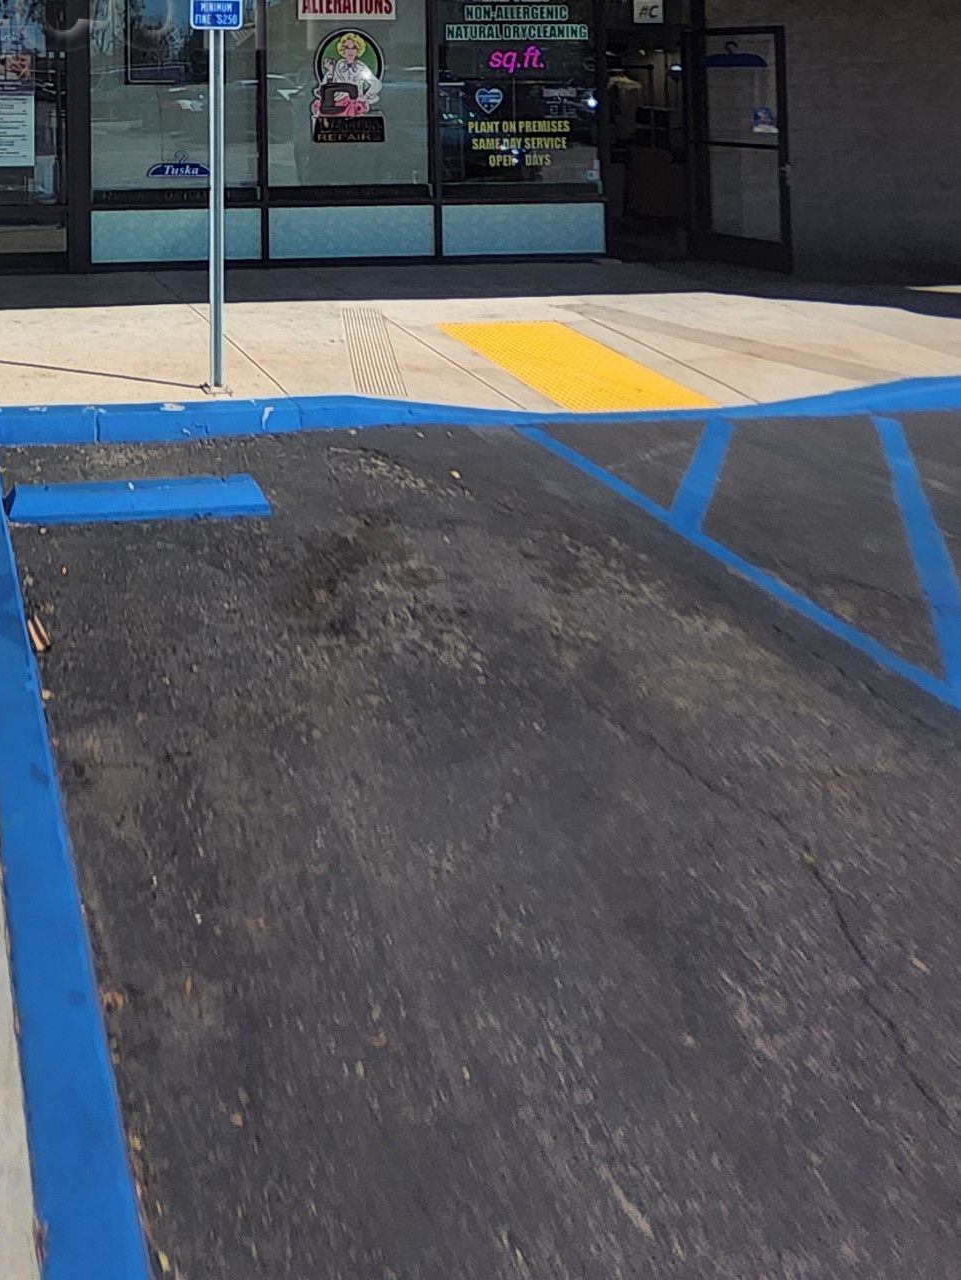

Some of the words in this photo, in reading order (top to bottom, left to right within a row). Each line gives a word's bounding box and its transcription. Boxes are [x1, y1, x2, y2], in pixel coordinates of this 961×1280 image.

[200, 2, 233, 13] MINIMUM
[464, 5, 569, 21] NON-ALLERGENIC
[446, 24, 501, 40] NATURAL
[502, 24, 588, 40] DRYCLEANING
[468, 121, 500, 134] PLANT
[502, 121, 517, 133] ON
[519, 120, 570, 133] PREMISES
[472, 137, 501, 150] SAME
[502, 137, 522, 149] DAY
[524, 136, 567, 149] SERVICE
[525, 154, 552, 166] DAYS
[164, 165, 199, 175] Tuska
